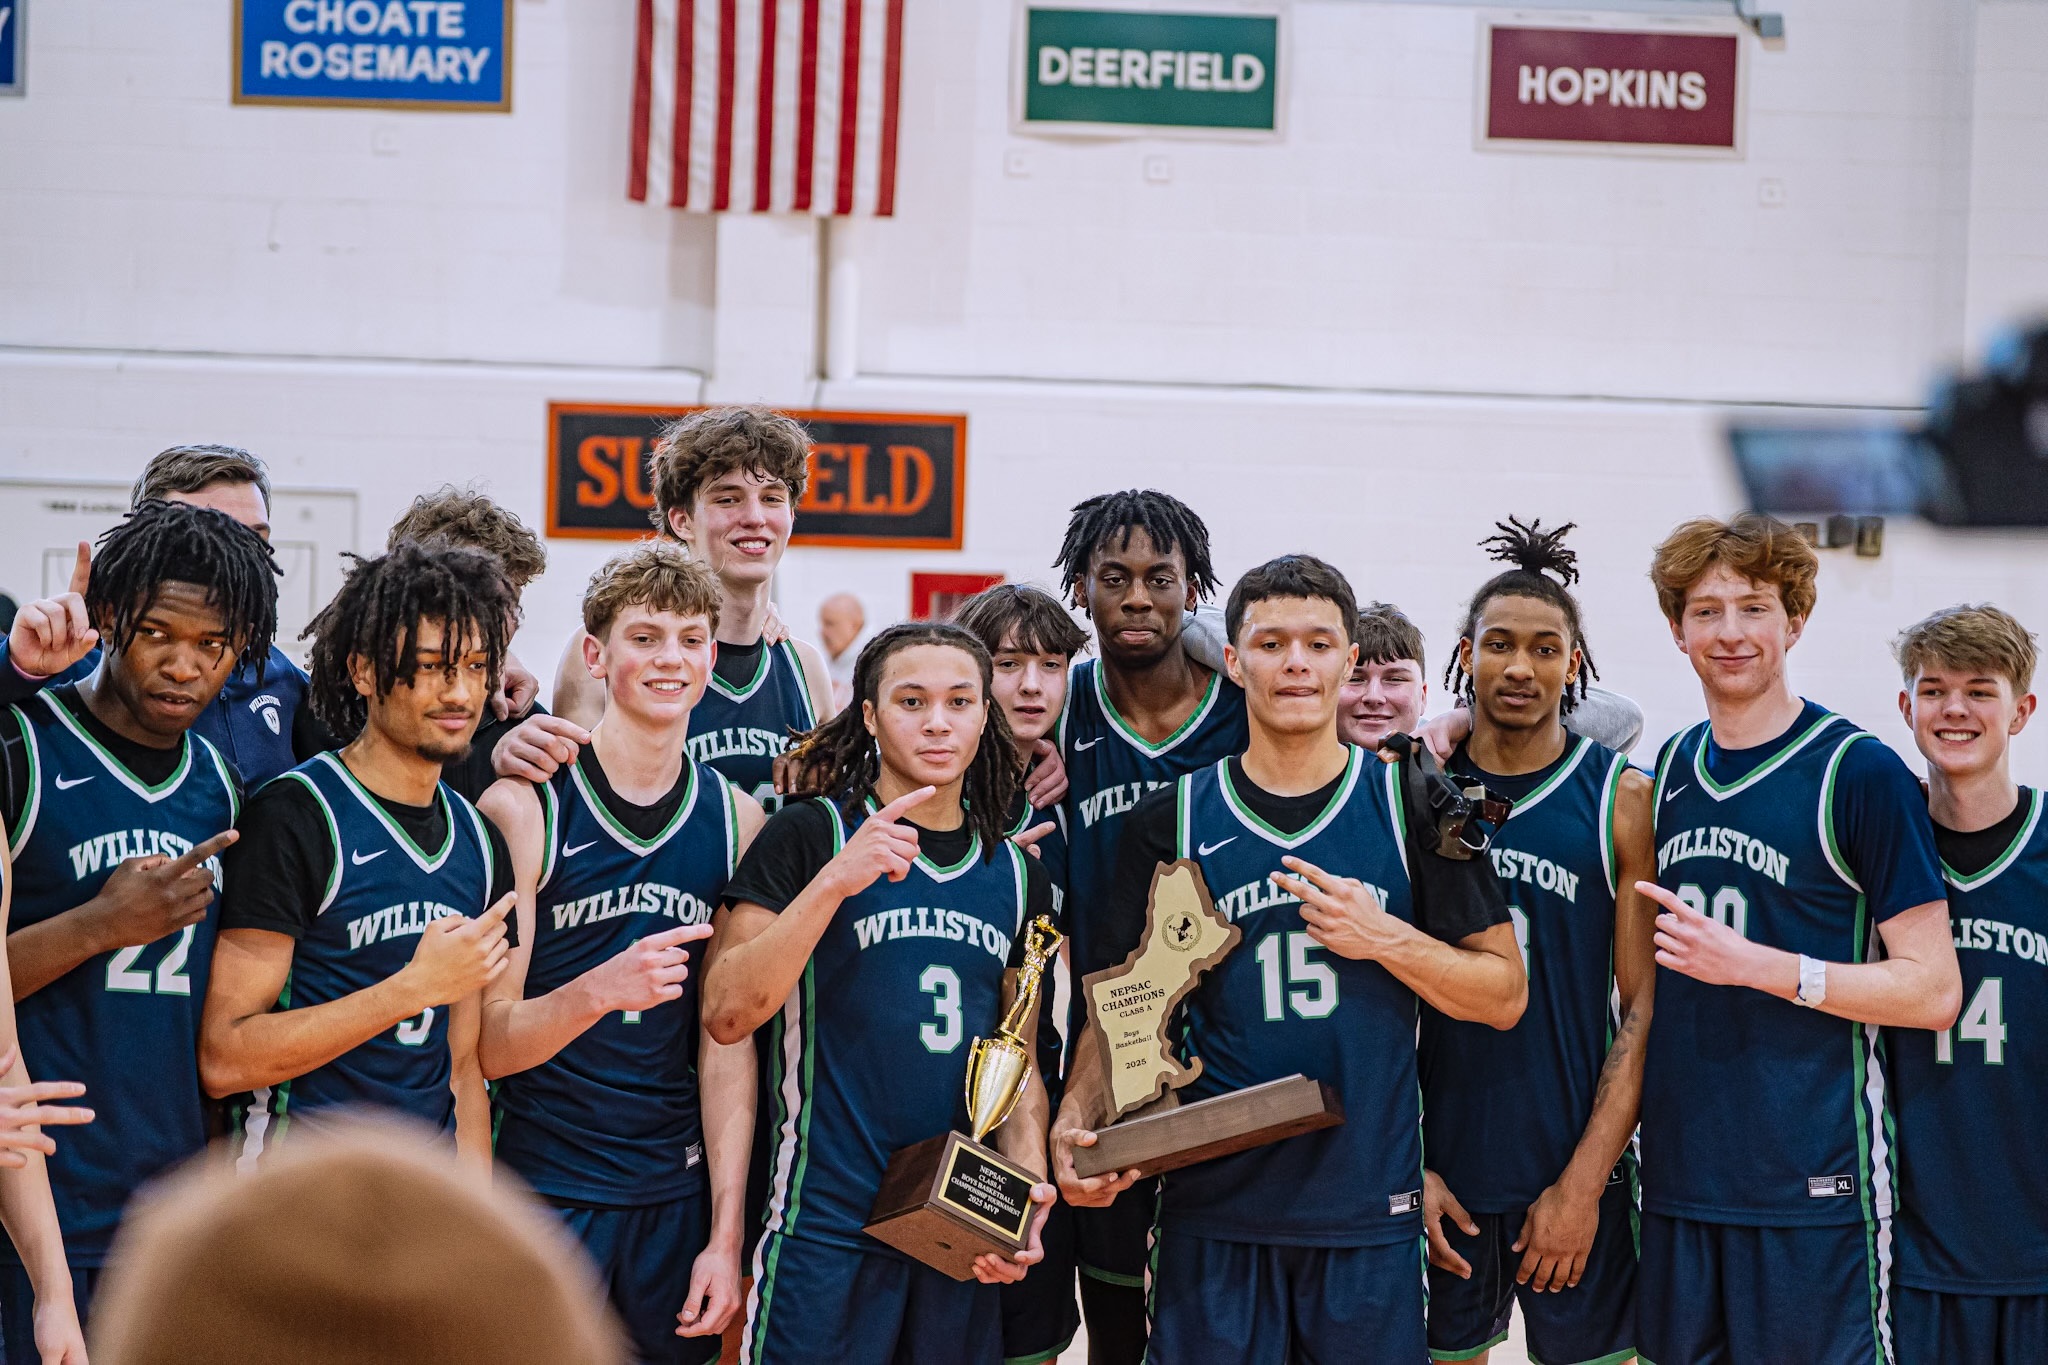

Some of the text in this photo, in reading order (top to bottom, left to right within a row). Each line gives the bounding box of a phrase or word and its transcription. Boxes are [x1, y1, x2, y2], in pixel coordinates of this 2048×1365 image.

[284, 0, 466, 38] CHOATE
[260, 40, 491, 84] ROSEMARY
[1038, 46, 1265, 92] DEERFIELD
[1518, 65, 1707, 111] HOPKINS
[577, 434, 936, 517] SUELD
[1657, 827, 1790, 887] WILLISTON
[1490, 848, 1579, 903] ISTON
[551, 882, 713, 931] WILLISTON
[853, 907, 1012, 968] WILLISTON
[1110, 980, 1152, 998] NEPSAC
[1255, 931, 1339, 1021] 15
[919, 964, 963, 1054] 3
[1101, 988, 1165, 1012] CHAMPIONS
[1119, 1007, 1144, 1018] CLASS
[1115, 1035, 1152, 1050] Basketball
[1123, 1030, 1140, 1039] Boys
[1125, 1058, 1147, 1069] 2025
[961, 1173, 1014, 1206] BOYS BASKETBALL
[979, 1174, 997, 1188] CLASS
[980, 1165, 1007, 1184] NEPSAC
[1612, 1170, 1618, 1179] L
[1837, 1180, 1851, 1190] XL
[951, 1177, 1021, 1217] CHAMPIONSHIP TOURNAMENT
[968, 1194, 999, 1215] 2025 MVP
[1413, 1196, 1418, 1205] L
